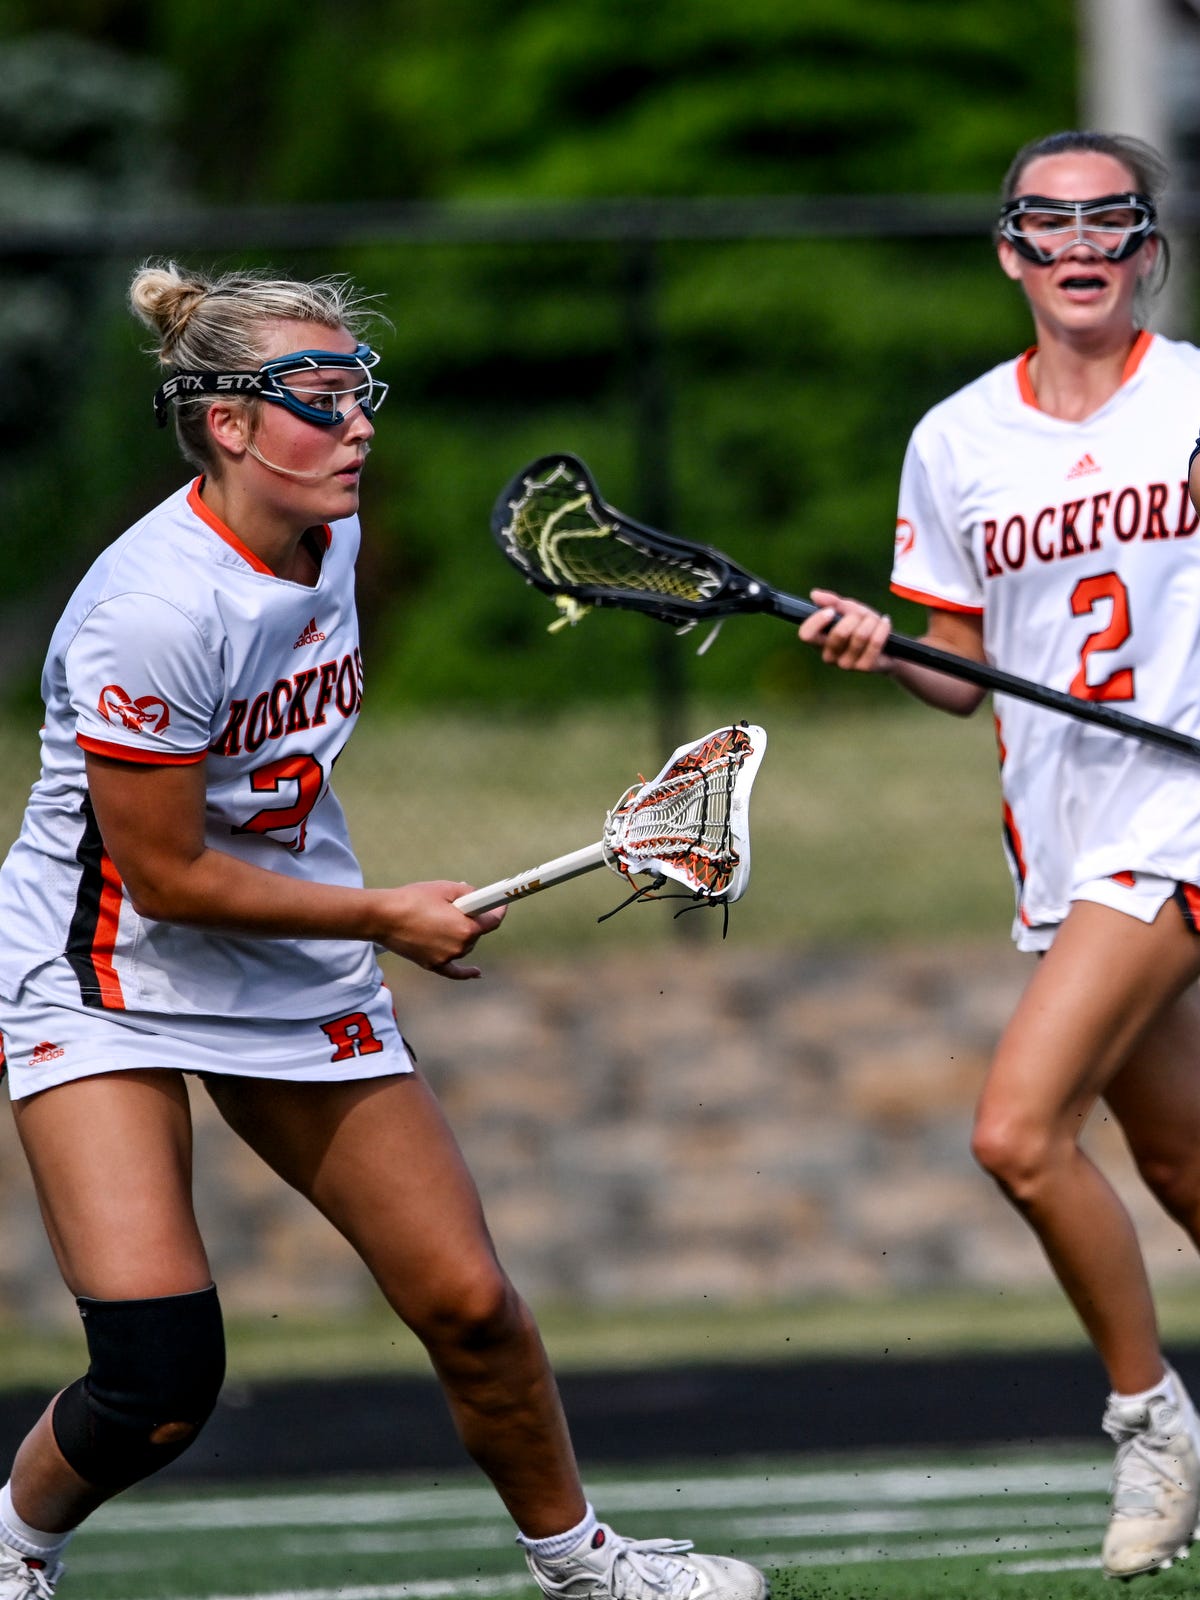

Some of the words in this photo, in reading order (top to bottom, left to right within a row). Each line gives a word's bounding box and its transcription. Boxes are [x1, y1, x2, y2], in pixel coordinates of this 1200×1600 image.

[216, 374, 263, 390] STX
[1069, 570, 1136, 703] 2
[319, 1012, 384, 1063] R
[28, 1048, 65, 1066] adidas
